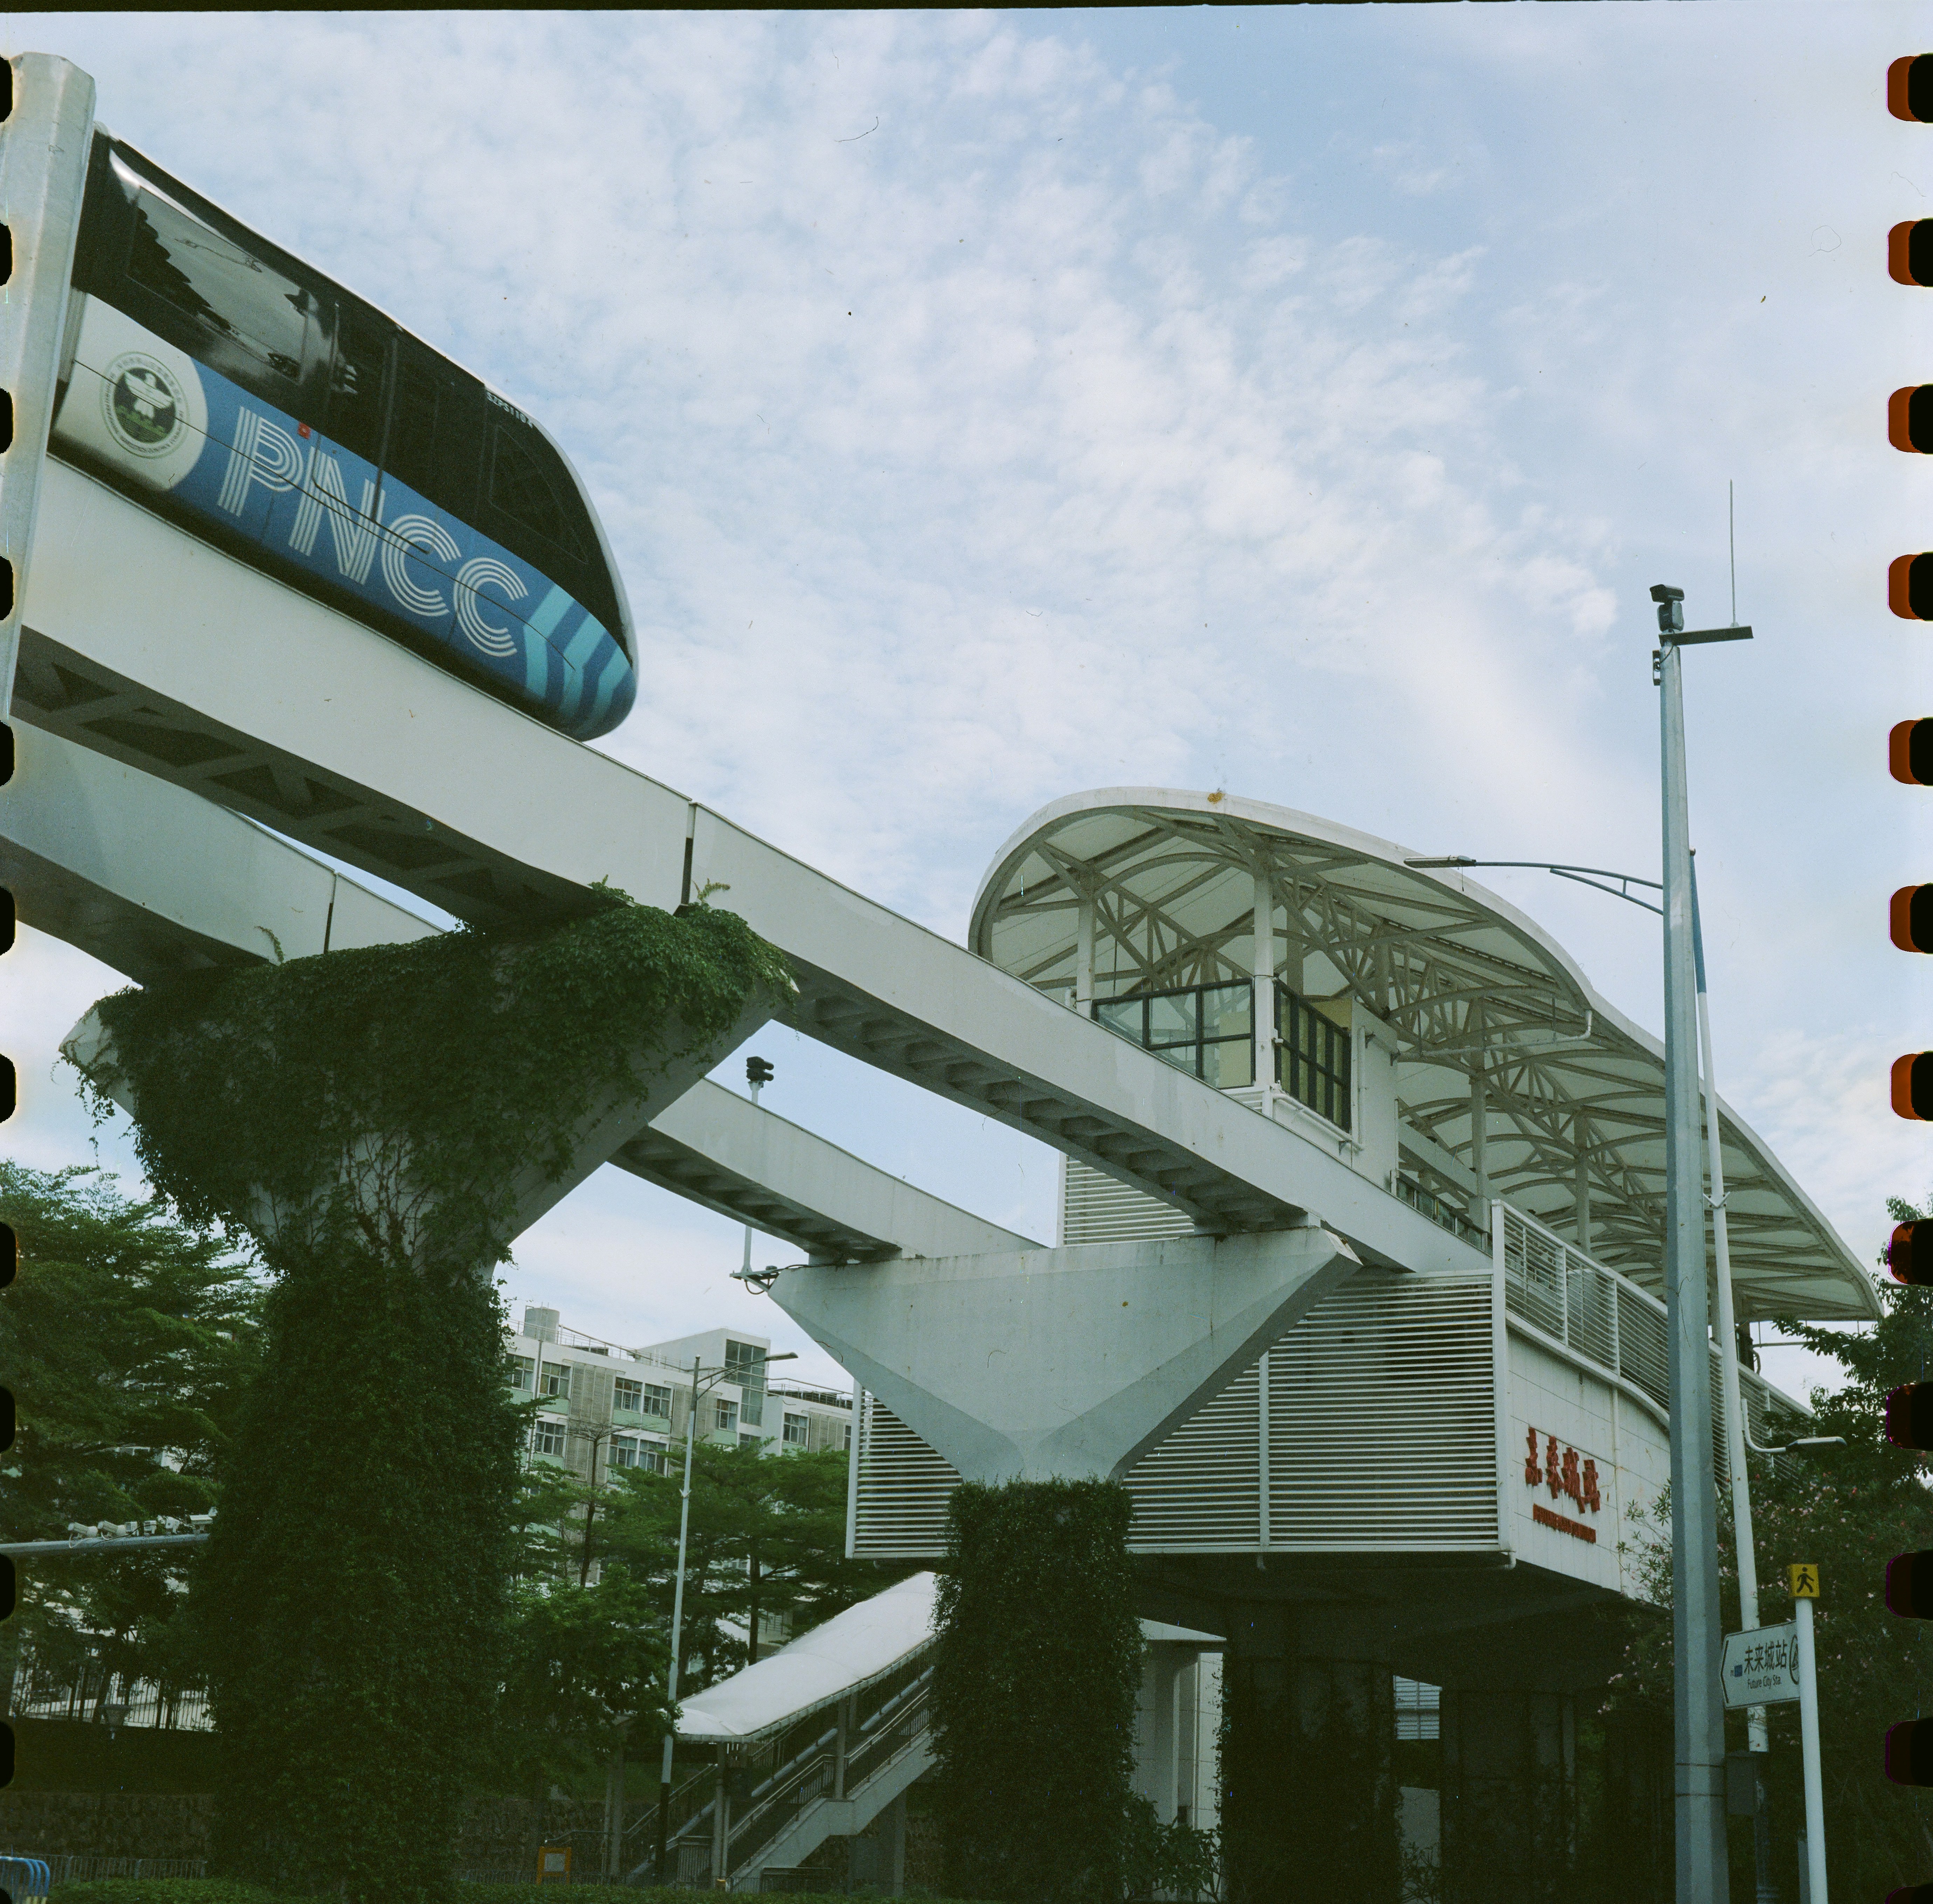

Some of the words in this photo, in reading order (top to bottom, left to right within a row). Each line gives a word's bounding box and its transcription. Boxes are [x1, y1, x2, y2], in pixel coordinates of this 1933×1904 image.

[218, 406, 529, 657] PNCC
[1744, 1639, 1788, 1675] 未来城站
[1747, 1678, 1762, 1689] Future
[1763, 1675, 1772, 1689] City
